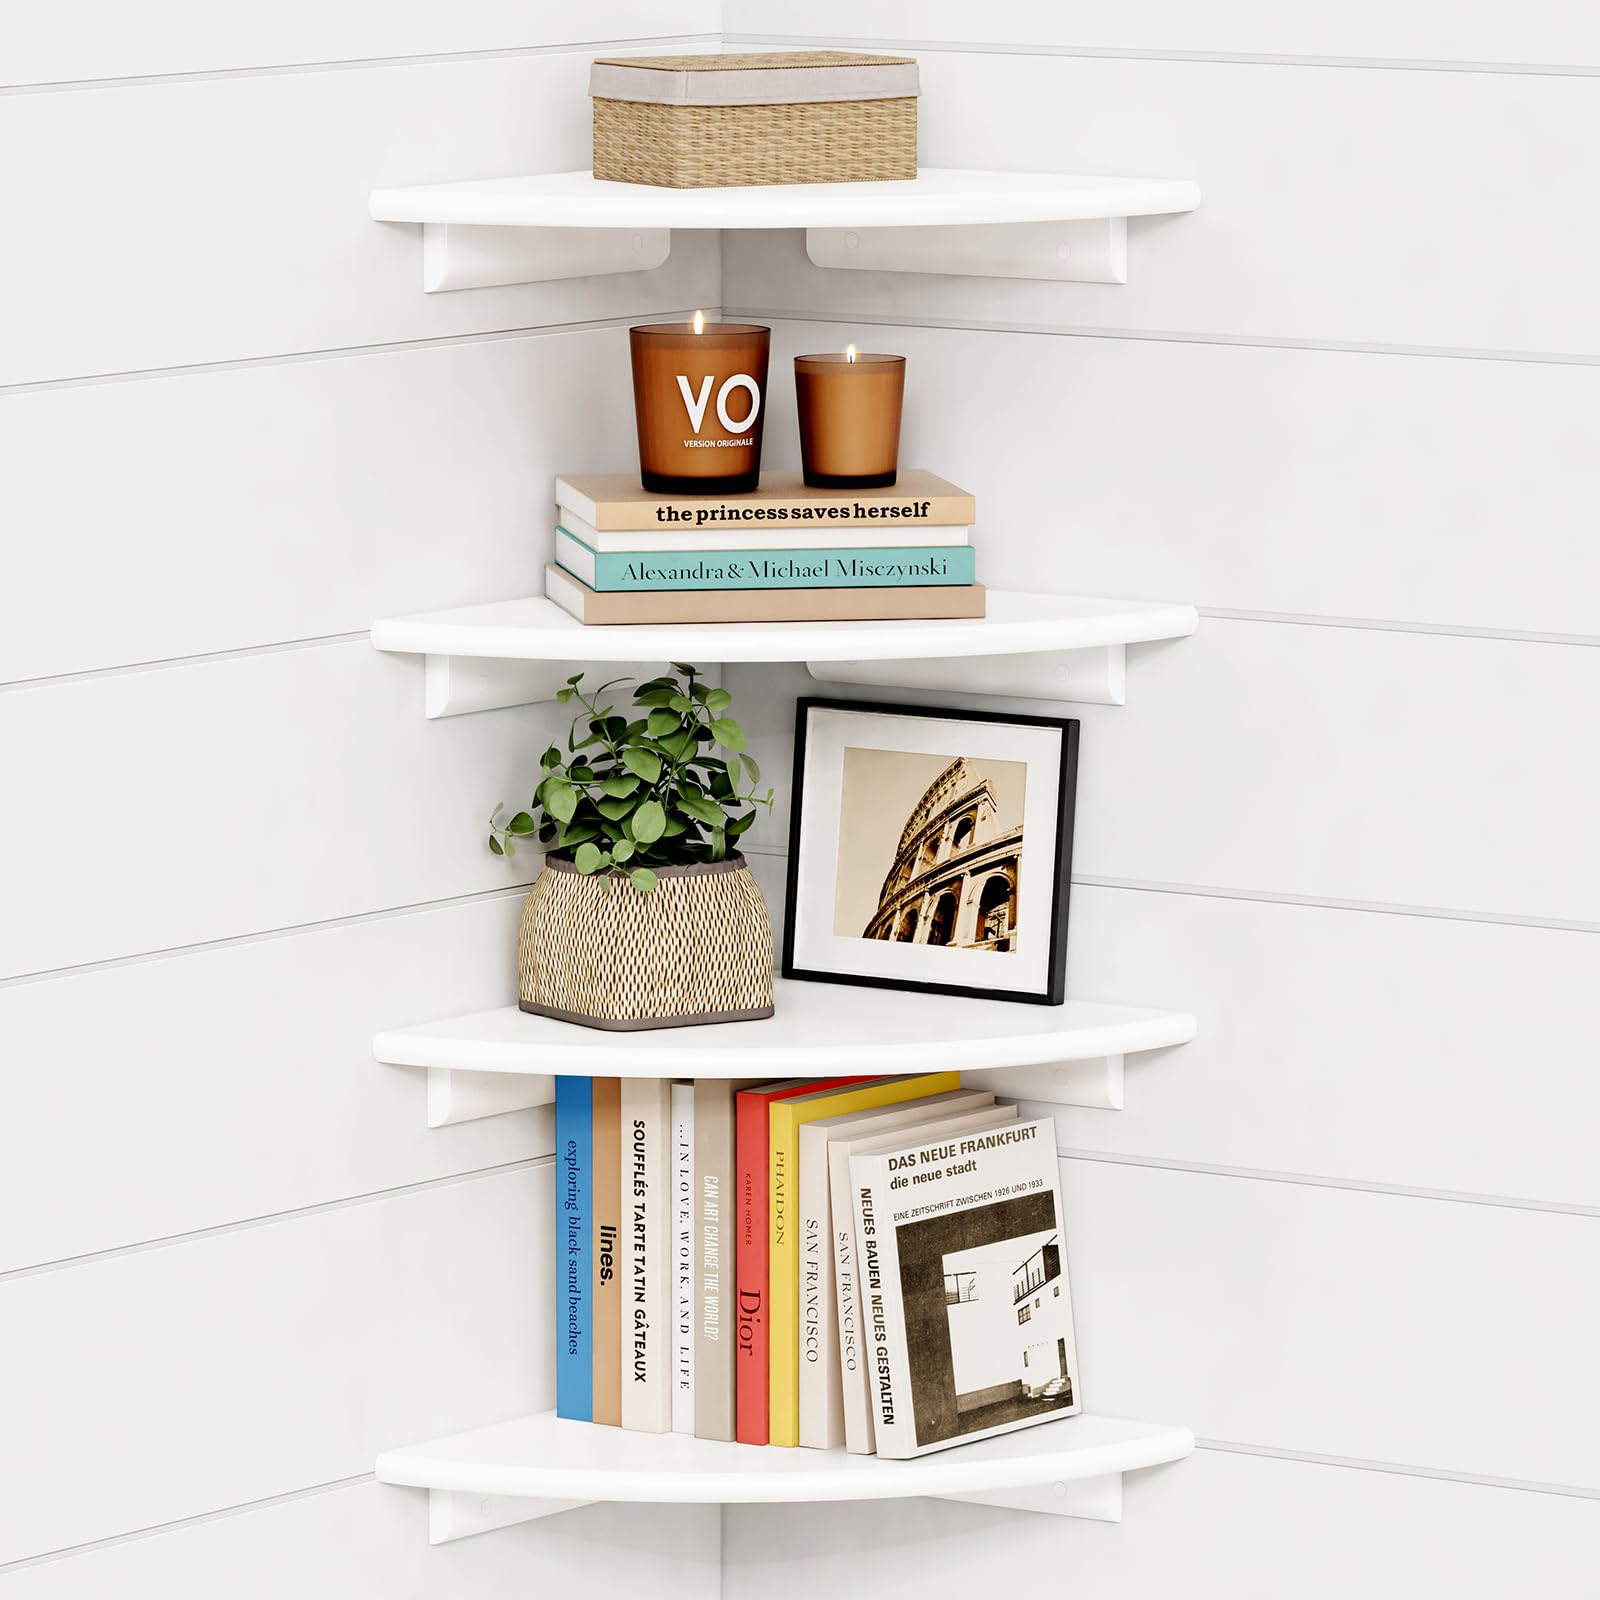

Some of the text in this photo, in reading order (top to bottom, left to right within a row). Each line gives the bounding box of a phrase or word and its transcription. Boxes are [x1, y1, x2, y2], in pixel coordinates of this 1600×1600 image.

[676, 373, 760, 434] VO
[656, 502, 930, 525] the princess saves herself
[621, 557, 947, 582] Alexandra & Michael Misczynski
[888, 1126, 1038, 1172] DAS NEUE FRANKFURT
[890, 1159, 977, 1190] die neue stadt
[776, 1151, 785, 1245] PHAIDON
[893, 1178, 1043, 1222] EINE ZEITSCHRIFT ZWISCHEN 1926 UND 1933
[565, 1140, 582, 1355] exploring black sand beaches
[600, 1225, 617, 1286] lines.
[634, 1119, 650, 1383] SOUFFLÉS TARTE TATIN GÂTEAUX
[704, 1175, 719, 1341] CAN ART CHANGE THE WORLD?
[680, 1296, 690, 1334] AND
[806, 1219, 819, 1363] SAN FRANCISCO
[839, 1232, 857, 1371] SAN FRANCISCO
[860, 1188, 895, 1425] NEUES BAUEN NEUES GESTALTEN
[739, 1288, 761, 1356] Dior
[680, 1346, 690, 1390] LIFE
